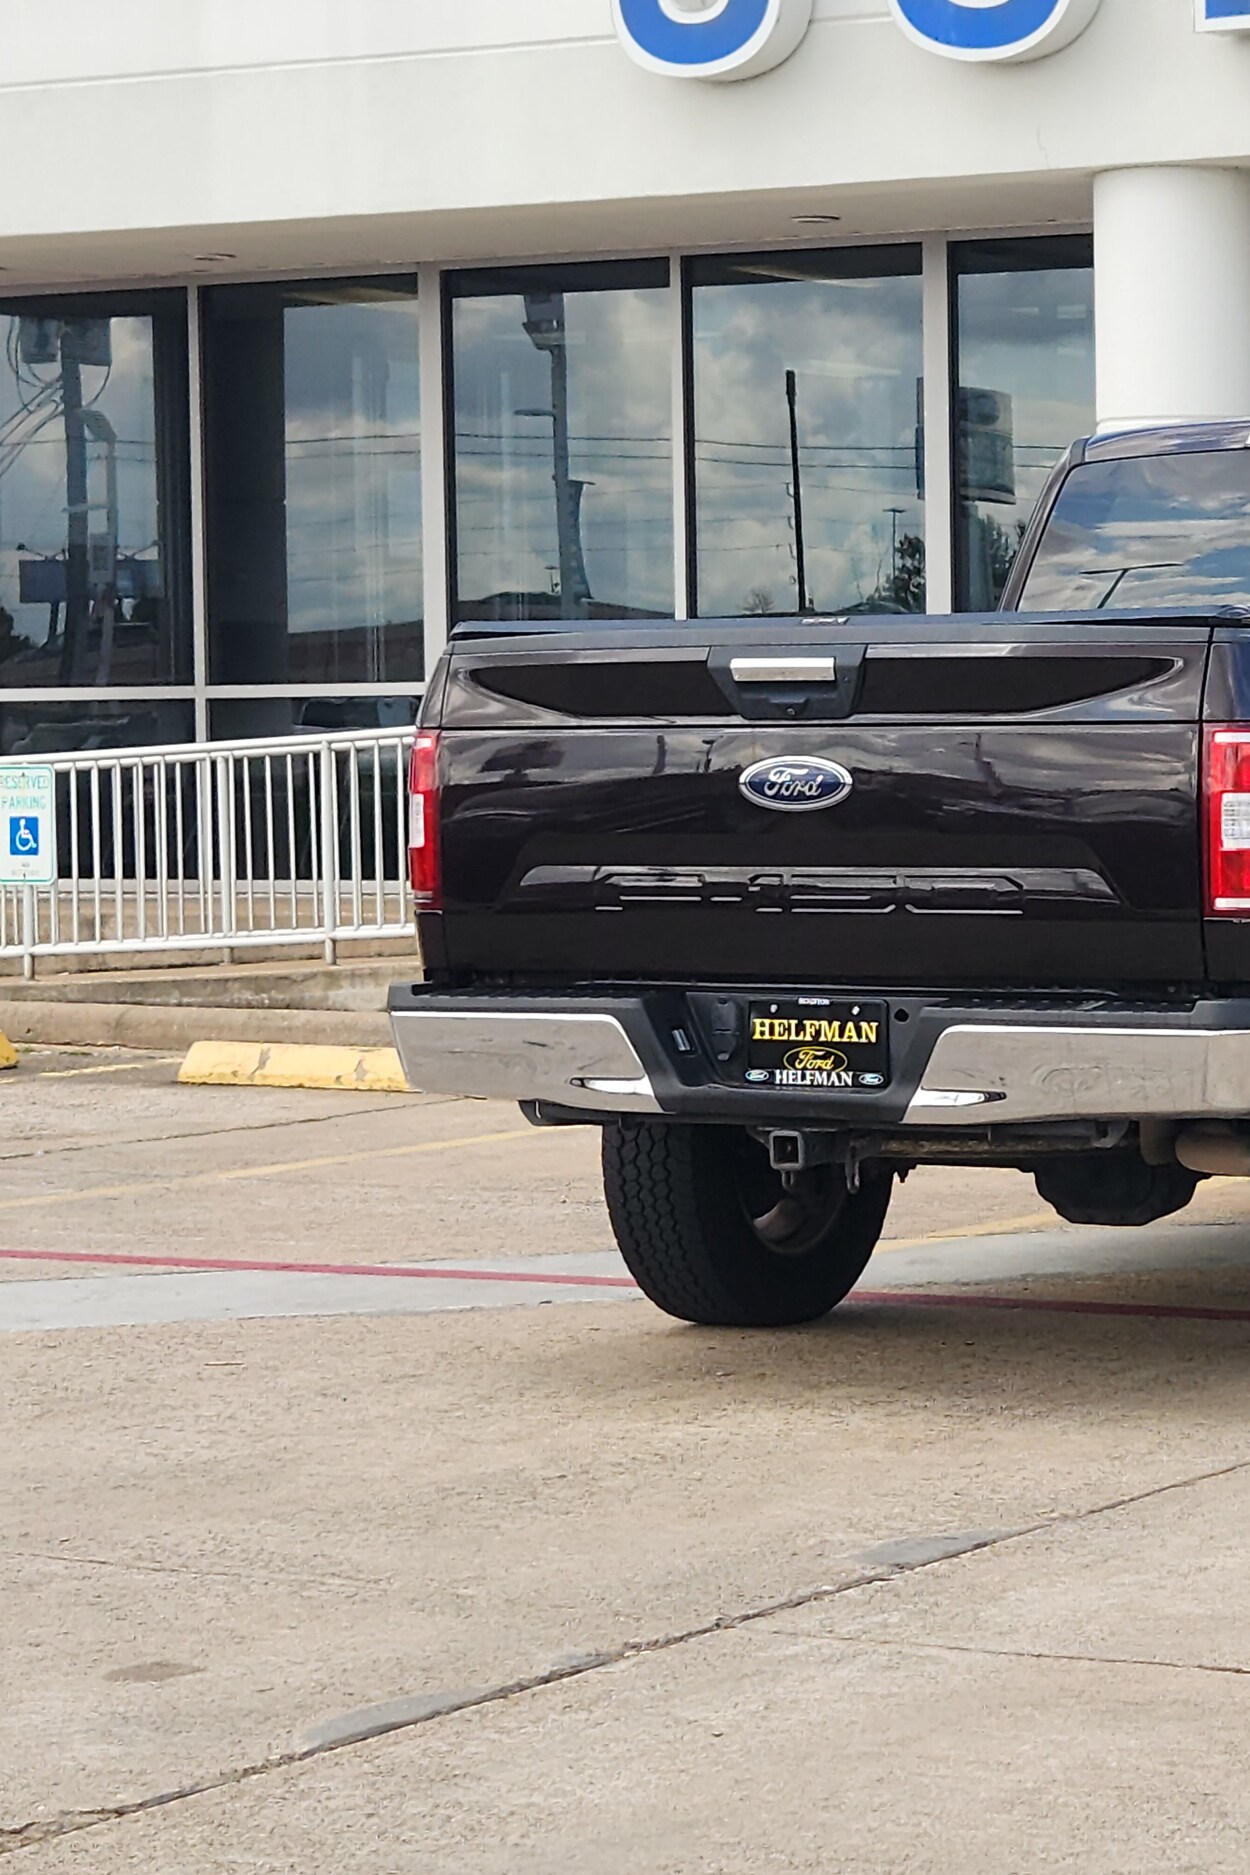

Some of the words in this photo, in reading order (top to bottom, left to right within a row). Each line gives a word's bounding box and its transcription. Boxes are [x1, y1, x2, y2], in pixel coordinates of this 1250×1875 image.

[764, 767, 824, 796] Ford
[752, 1018, 879, 1043] HELFMAN
[794, 1050, 834, 1071] Ford
[774, 1069, 853, 1087] HELFMAN
